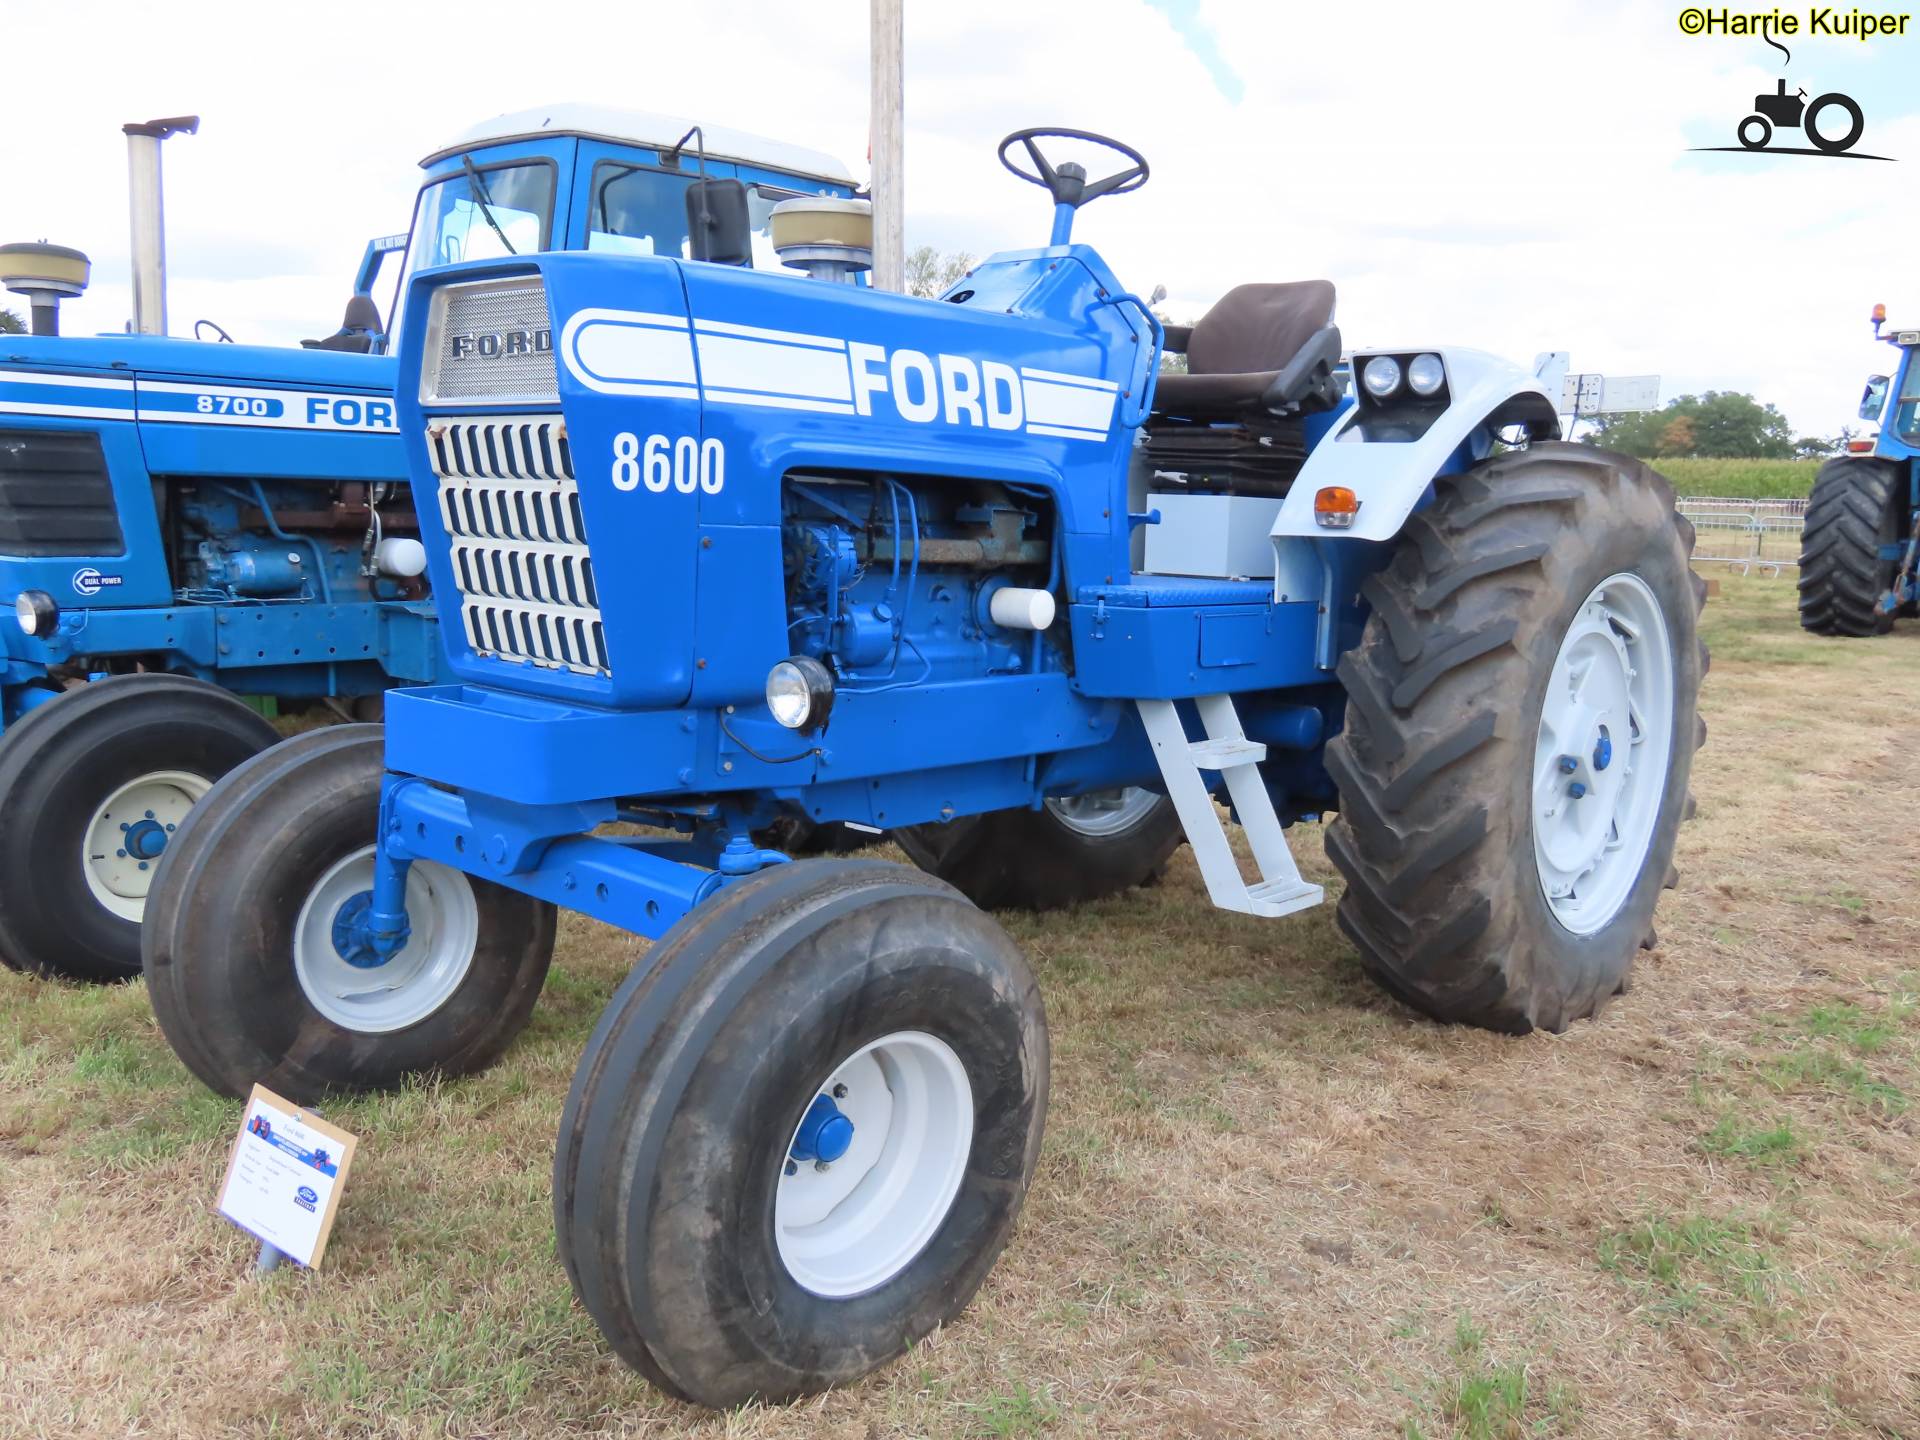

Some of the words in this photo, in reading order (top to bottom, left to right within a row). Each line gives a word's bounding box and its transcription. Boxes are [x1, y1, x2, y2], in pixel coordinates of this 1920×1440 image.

[452, 331, 554, 361] FORD
[848, 341, 1024, 432] FORD
[196, 395, 268, 416] 8700
[306, 397, 400, 428] FOR
[611, 432, 725, 495] 8600
[101, 577, 122, 585] POWER
